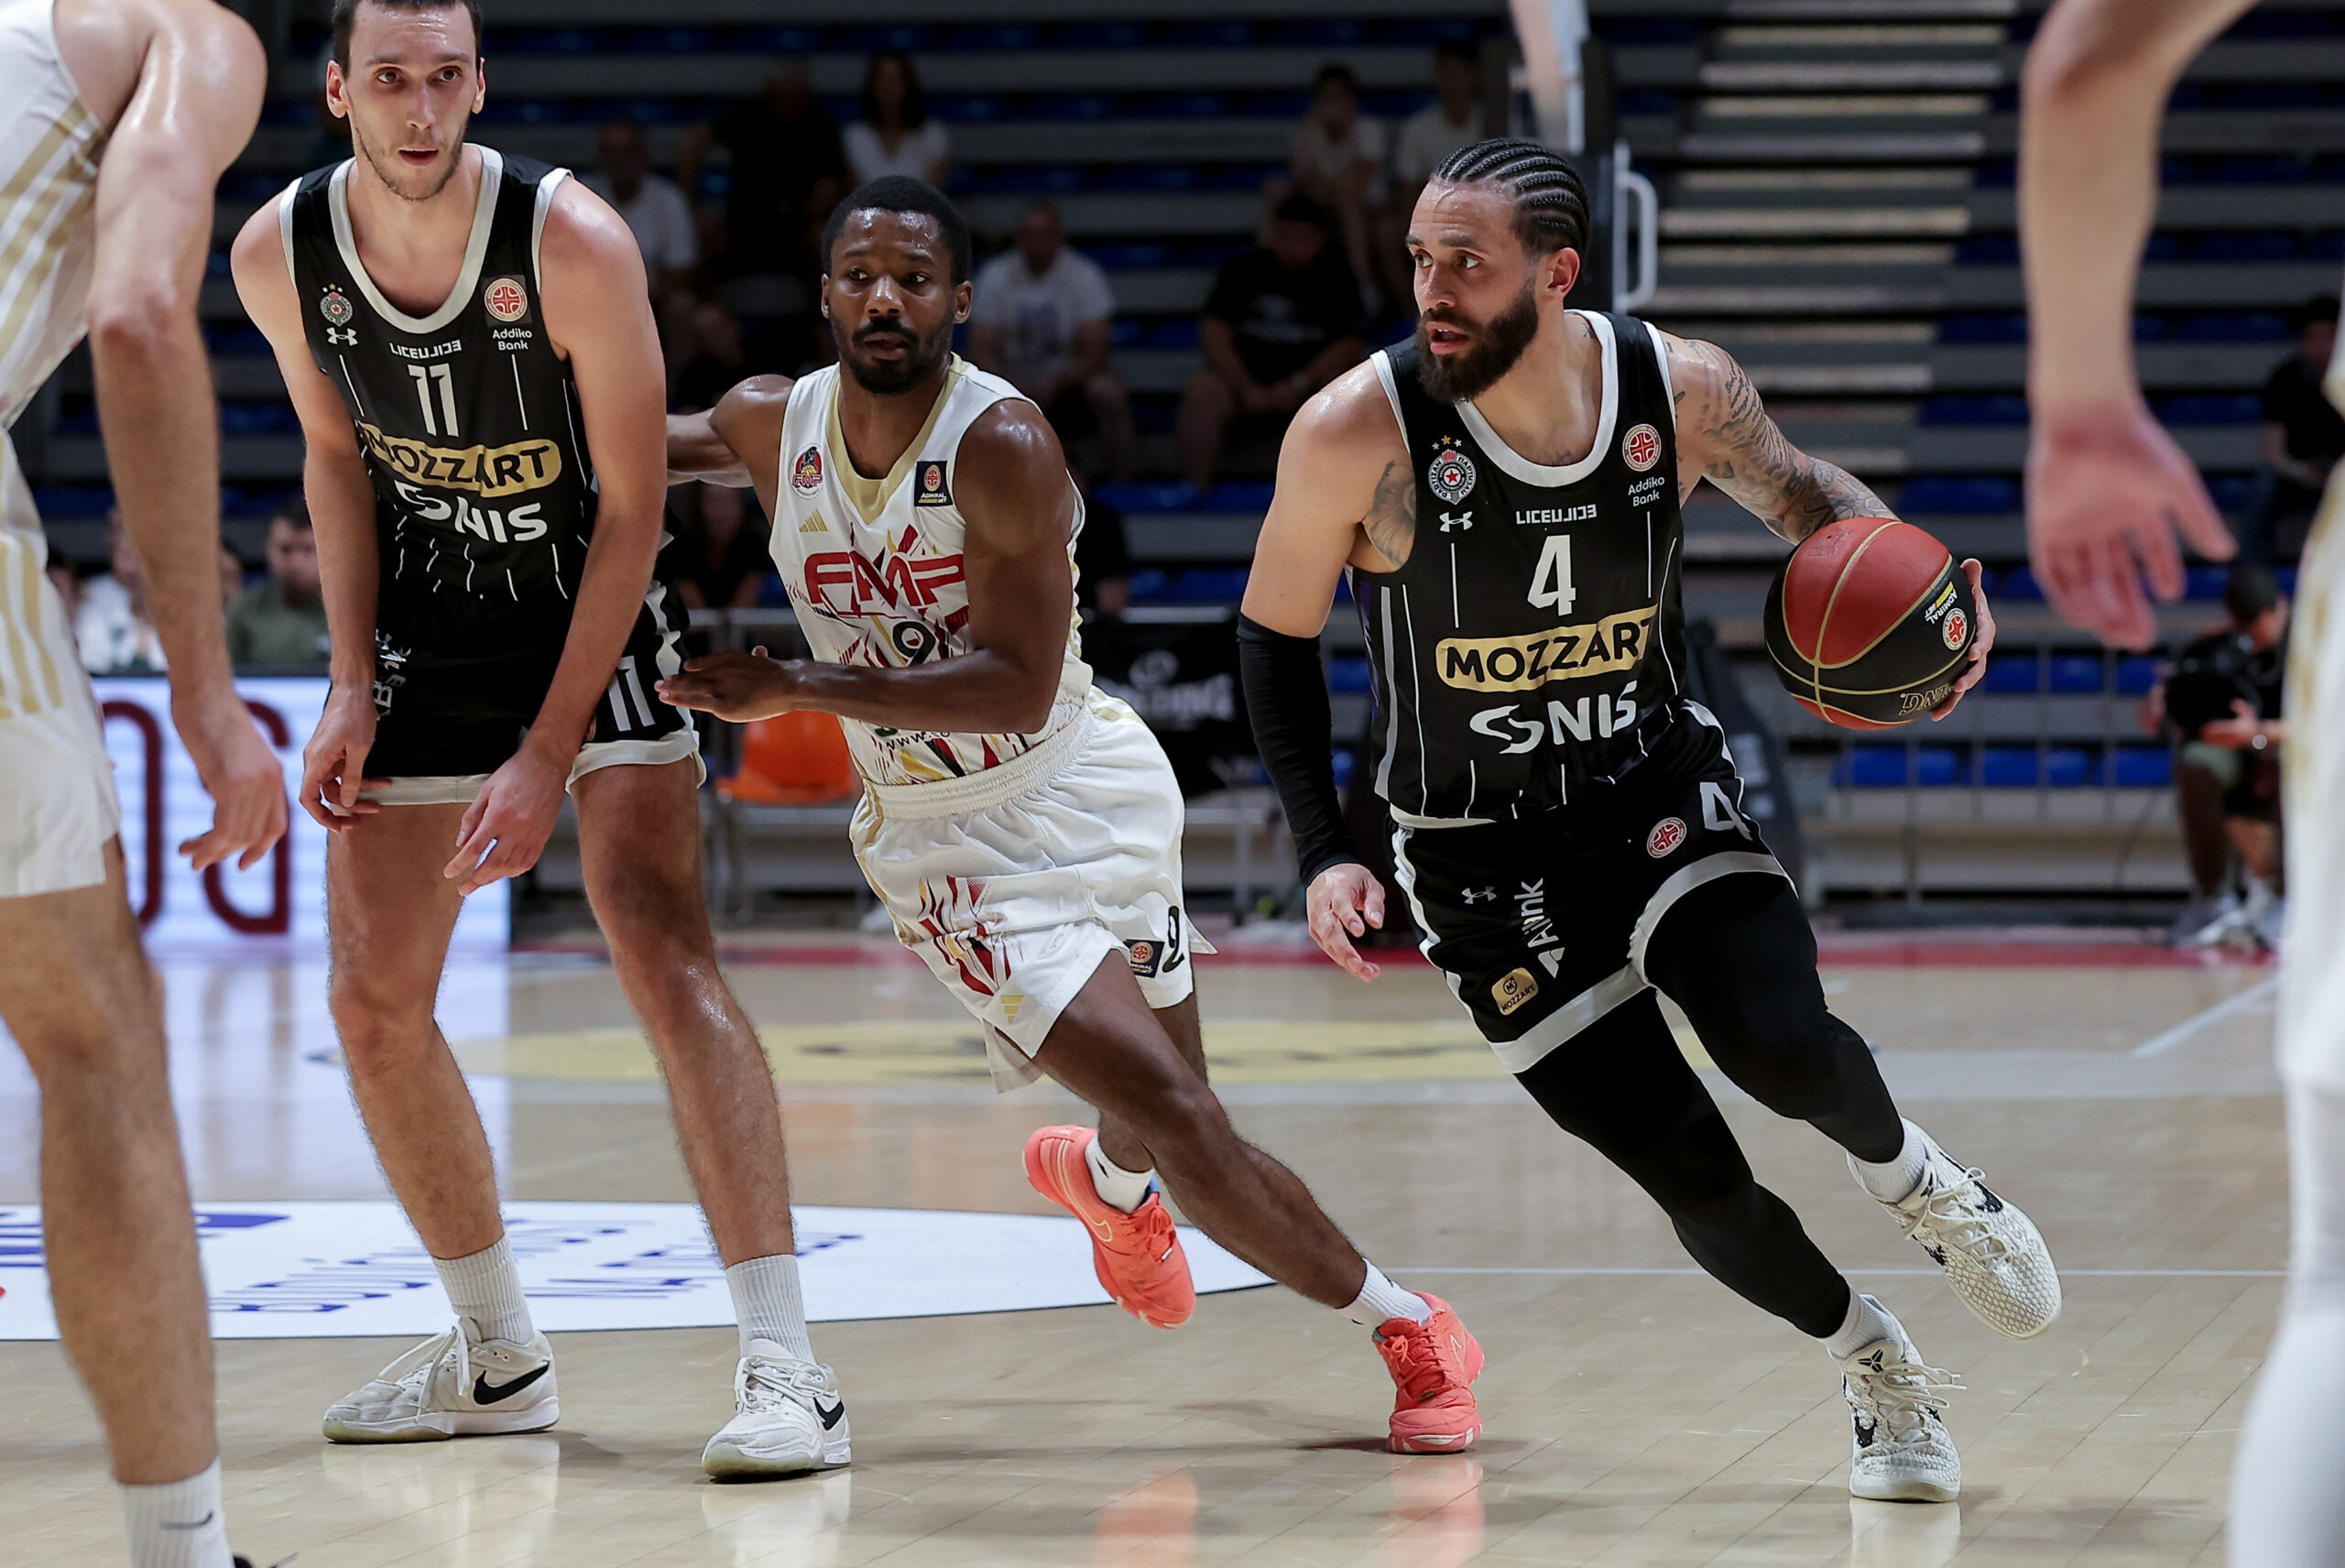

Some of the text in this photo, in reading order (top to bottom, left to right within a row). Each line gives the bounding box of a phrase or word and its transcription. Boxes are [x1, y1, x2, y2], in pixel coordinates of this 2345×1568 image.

[492, 328, 533, 340] Addiko
[497, 340, 529, 351] Bank
[407, 363, 460, 438] 11
[792, 474, 823, 486] FMP
[1627, 476, 1665, 495] Addiko
[1632, 490, 1660, 507] Bank
[804, 550, 965, 611] FMP
[1527, 534, 1576, 616] 4
[1925, 588, 1958, 624] ADMIRAL
[1445, 617, 1650, 683] MOZZAR
[1501, 984, 1536, 1013] MOZZART
